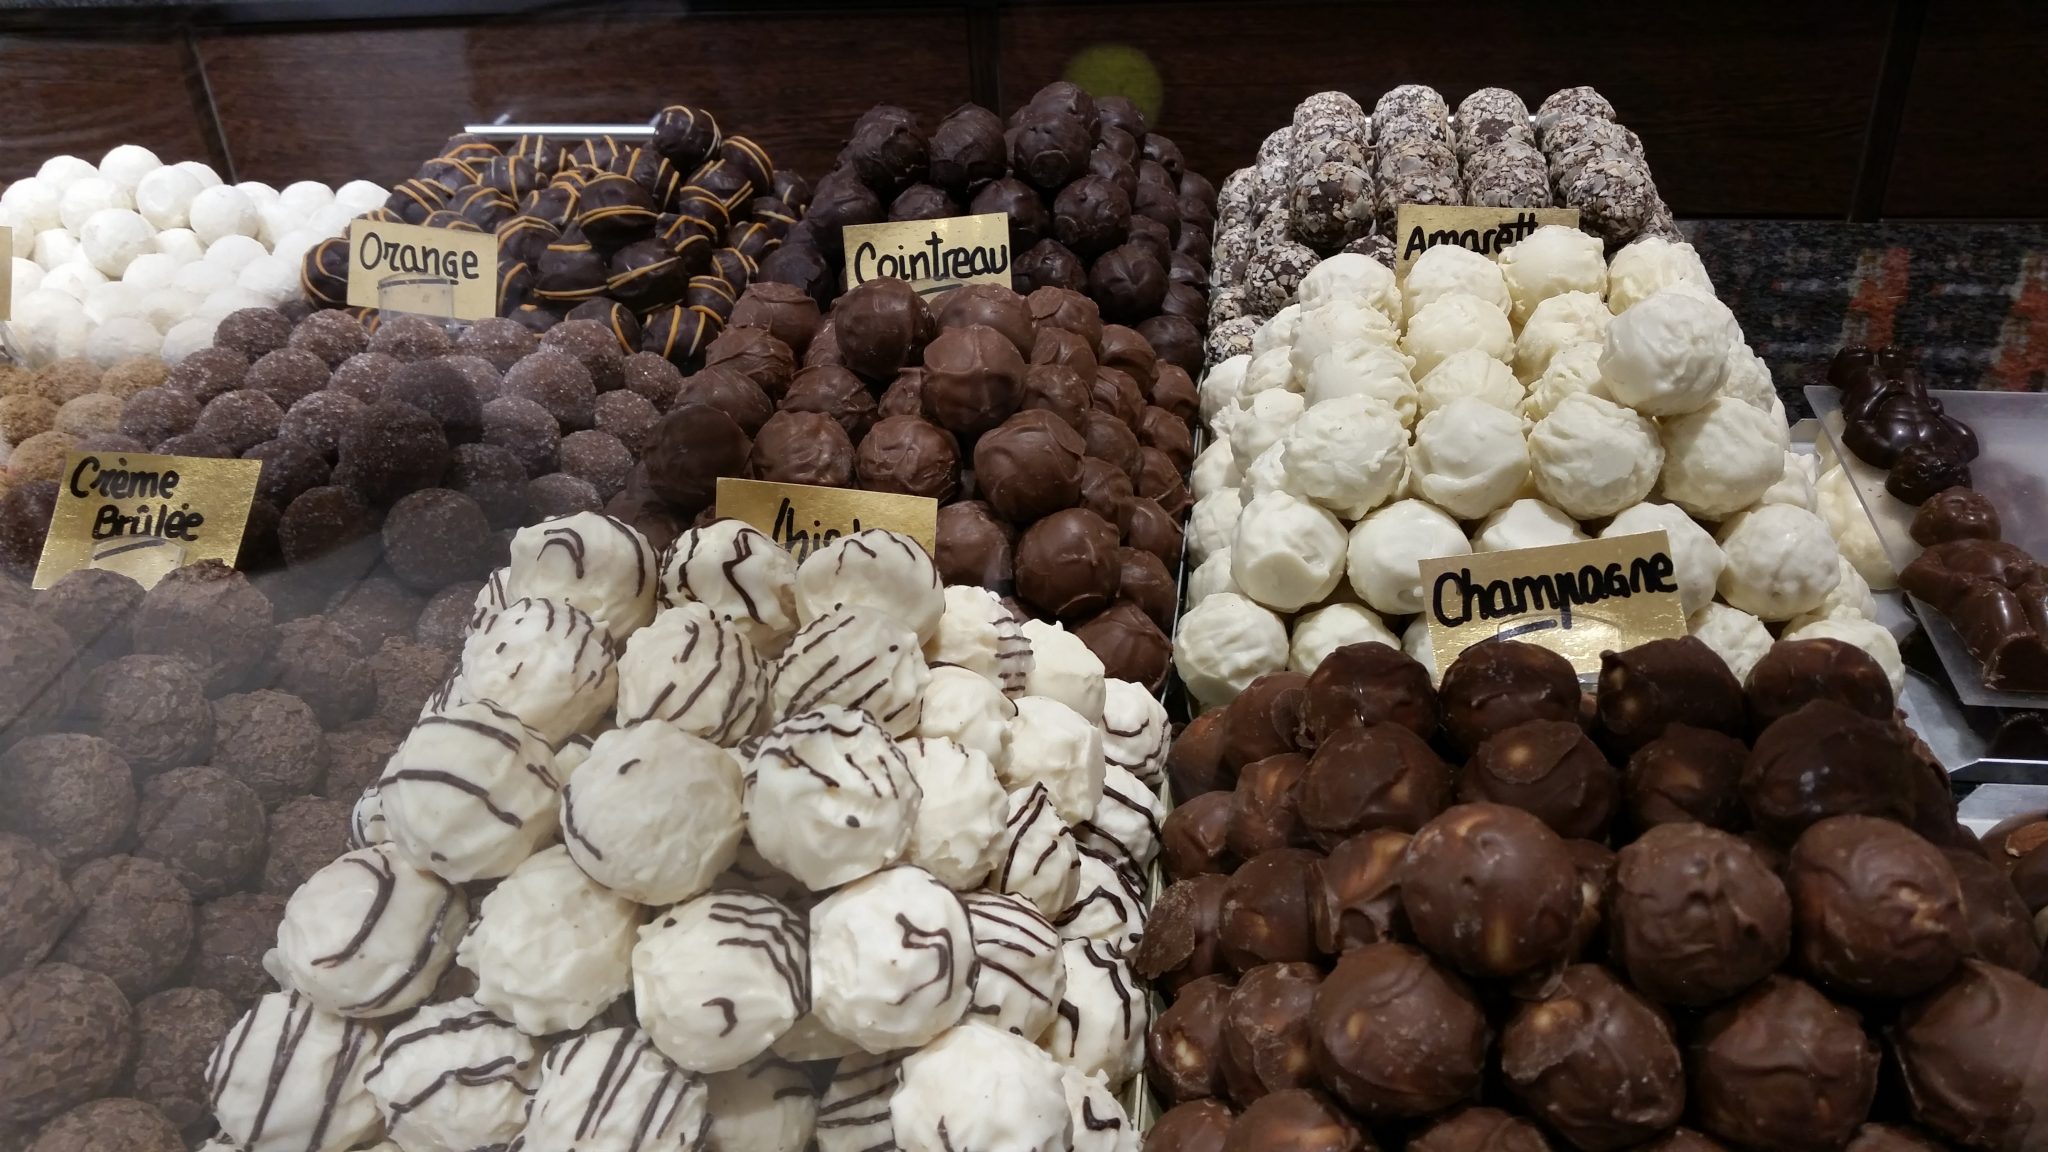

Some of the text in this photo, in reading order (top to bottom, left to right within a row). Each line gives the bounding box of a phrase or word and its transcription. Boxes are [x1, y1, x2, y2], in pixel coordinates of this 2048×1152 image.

[360, 232, 480, 280] Orange
[854, 231, 1009, 285] Cointreau
[1403, 212, 1539, 260] Amarett
[70, 456, 180, 499] Crème
[92, 503, 205, 542] Brûlée
[1433, 552, 1679, 630] Champagne
